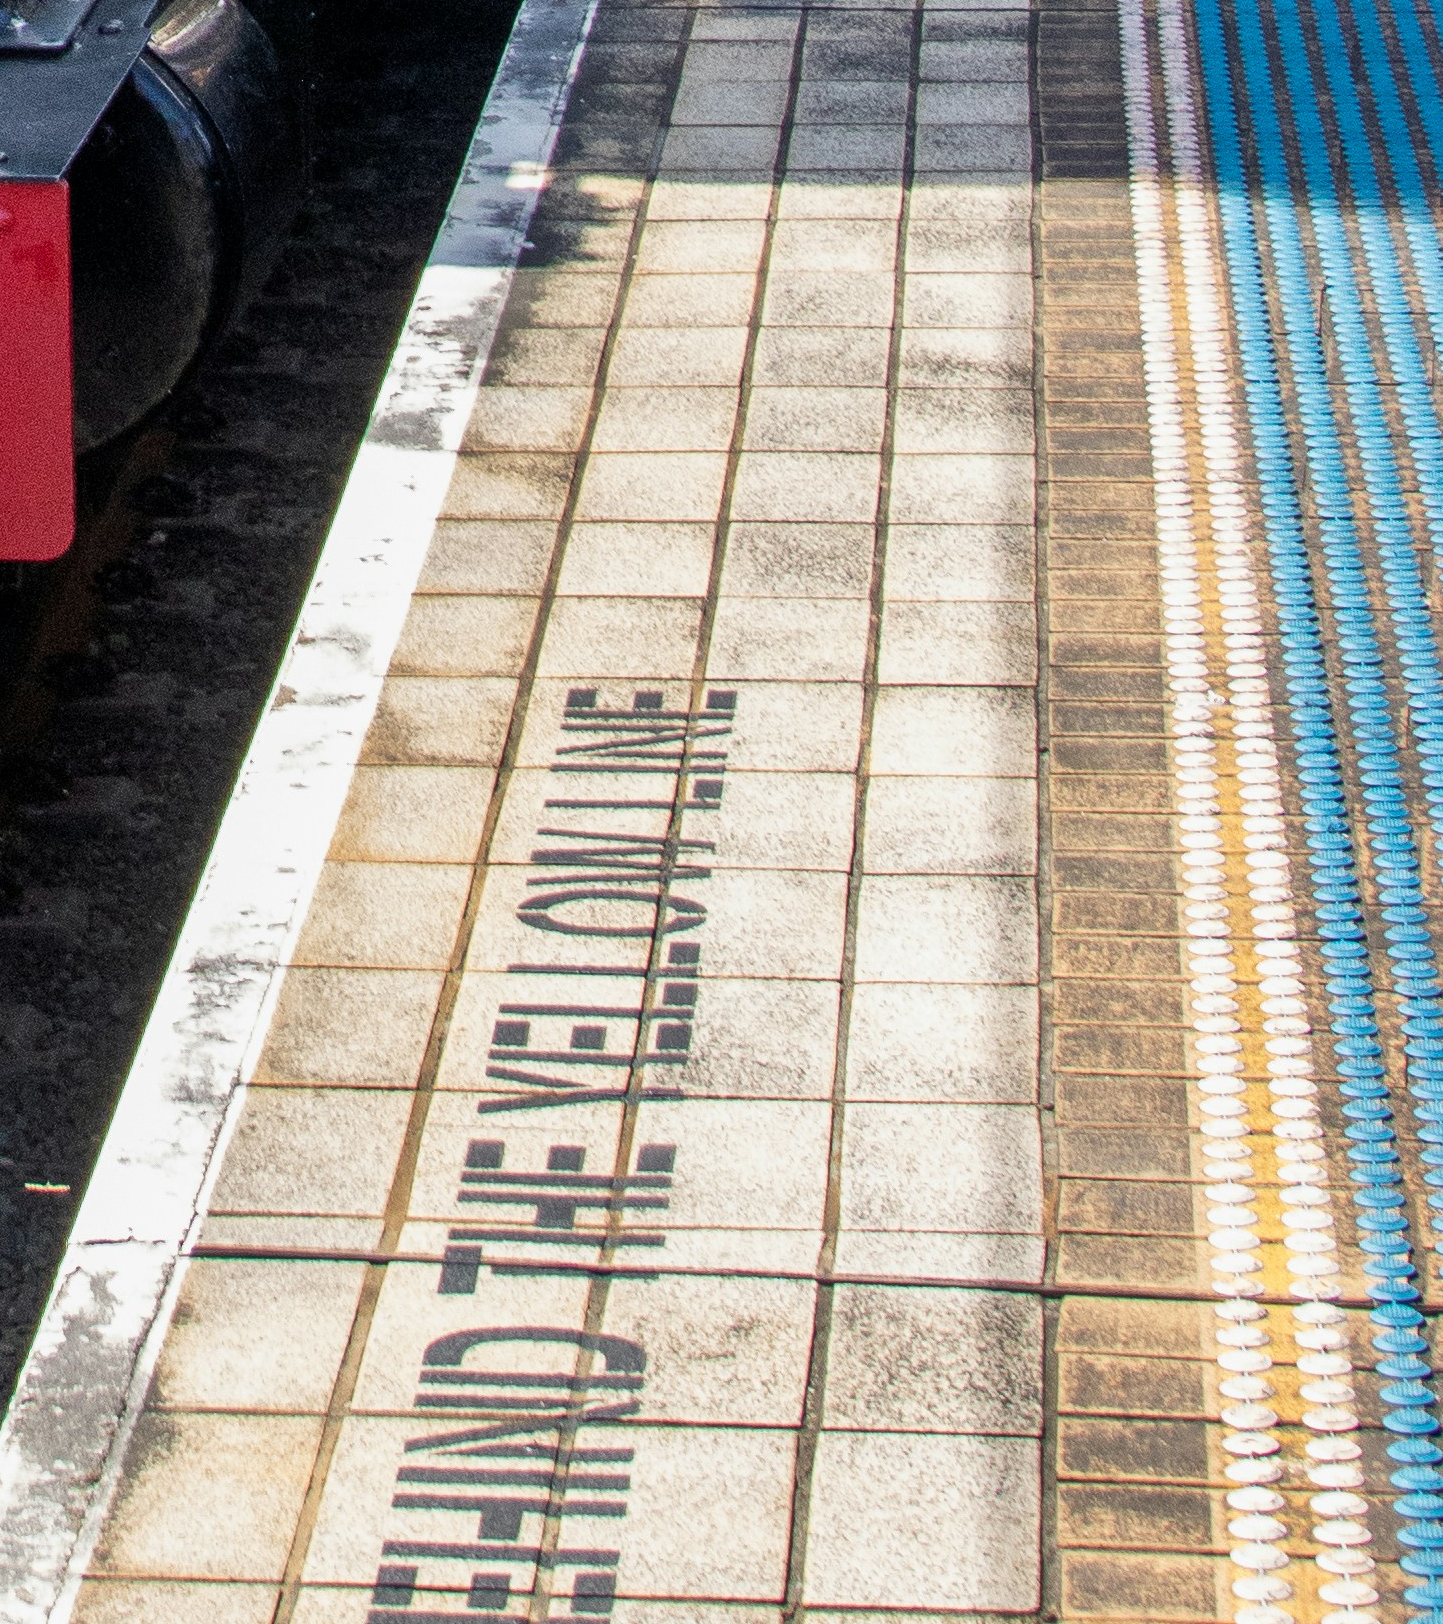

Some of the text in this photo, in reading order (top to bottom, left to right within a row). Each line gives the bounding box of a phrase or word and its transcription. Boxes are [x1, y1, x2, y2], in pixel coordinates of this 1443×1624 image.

[544, 687, 738, 811] LINE
[477, 827, 717, 1114] YELLOW
[438, 1139, 677, 1295] THE
